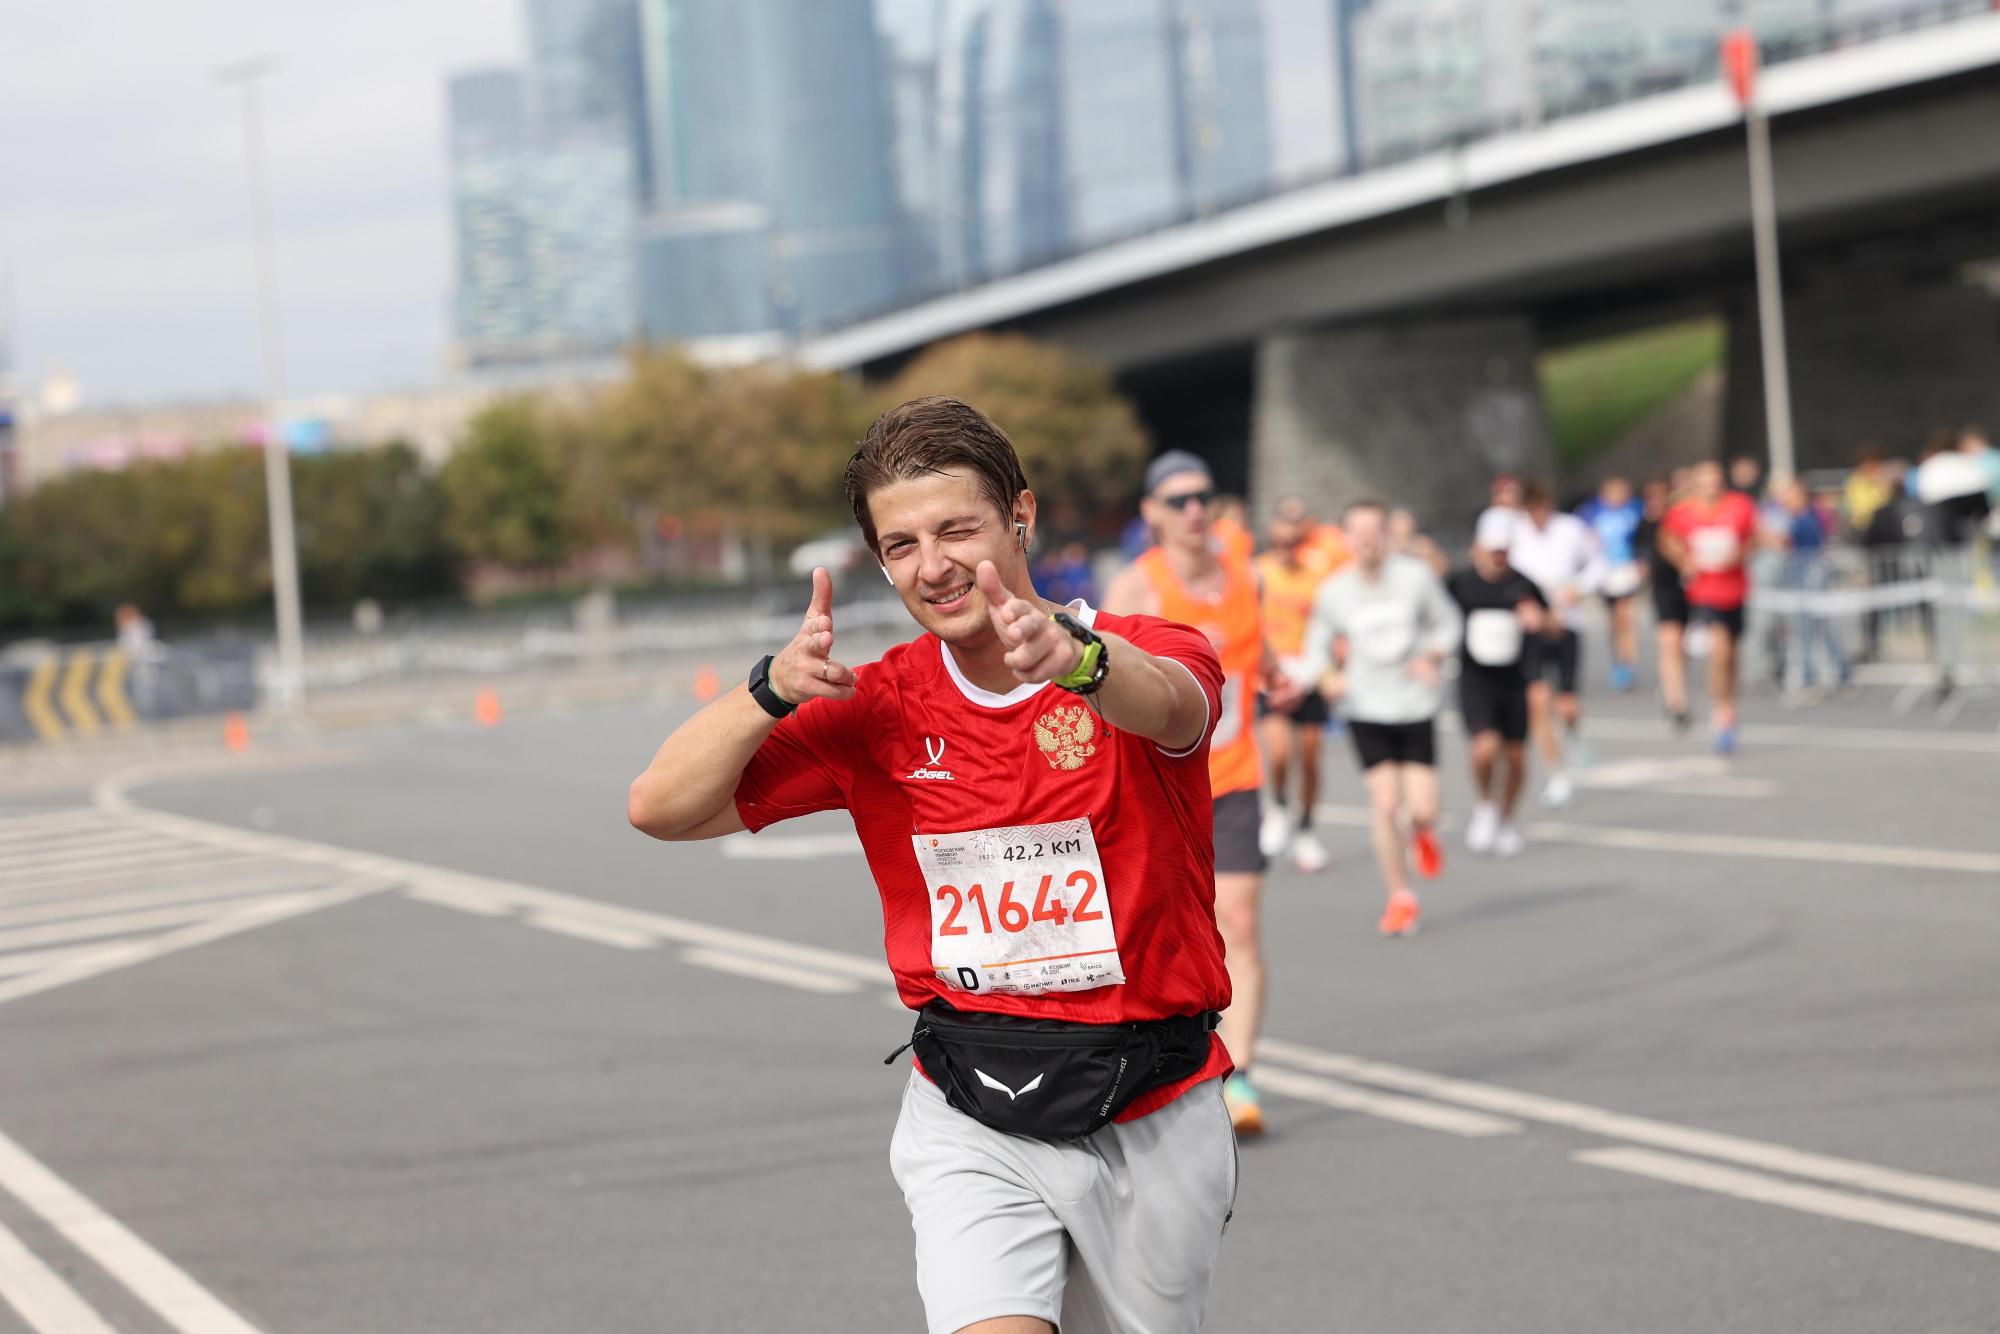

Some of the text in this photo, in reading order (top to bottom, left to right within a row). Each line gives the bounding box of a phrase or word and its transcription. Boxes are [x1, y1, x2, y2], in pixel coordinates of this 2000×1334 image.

[906, 768, 954, 780] JÖGEL
[1003, 843, 1044, 861] 42,2
[936, 870, 1103, 936] 21642
[957, 967, 979, 990] D
[1100, 1102, 1110, 1116] LITE
